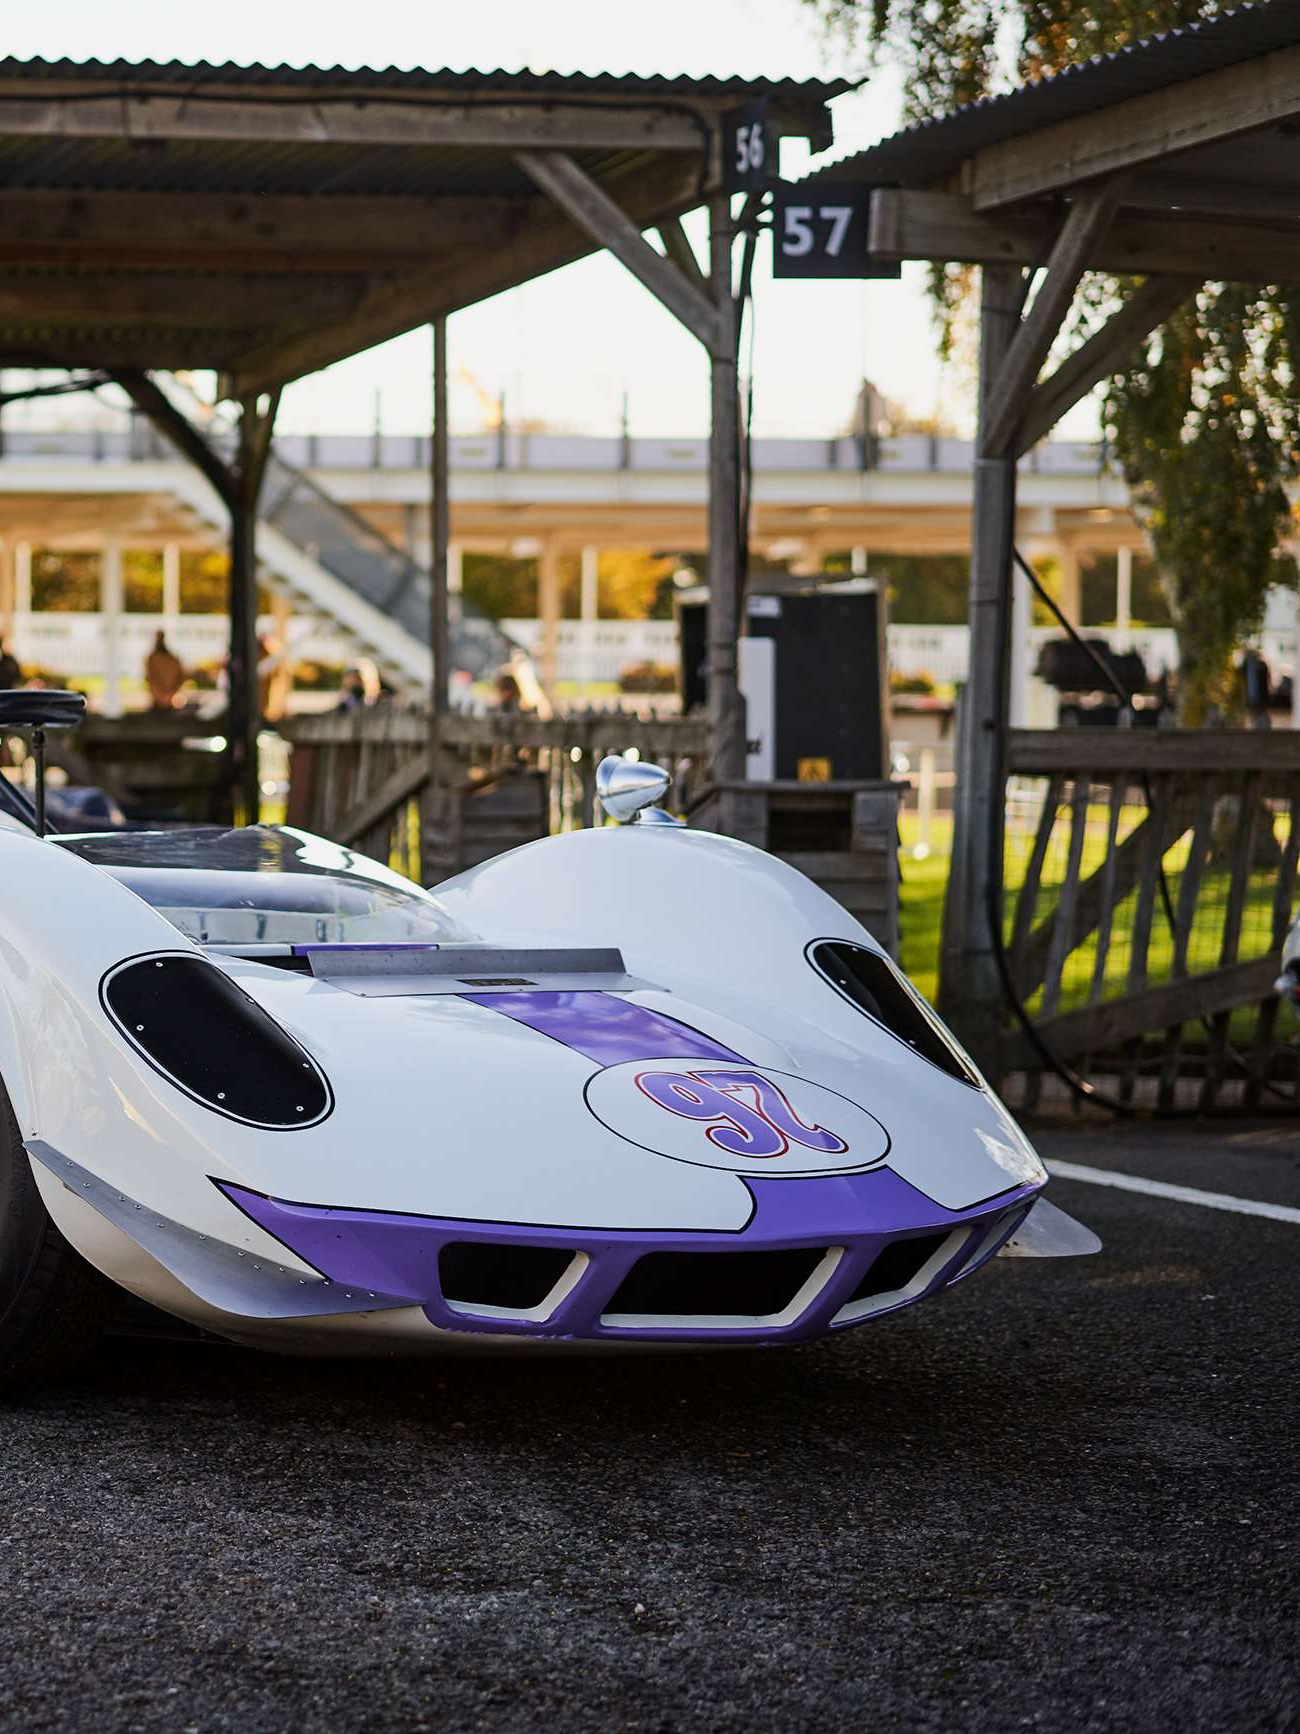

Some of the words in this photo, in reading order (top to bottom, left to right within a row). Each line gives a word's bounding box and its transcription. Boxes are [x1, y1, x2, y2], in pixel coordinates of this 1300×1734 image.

[735, 122, 765, 174] 56
[781, 206, 854, 258] 57
[634, 1069, 850, 1159] 97
